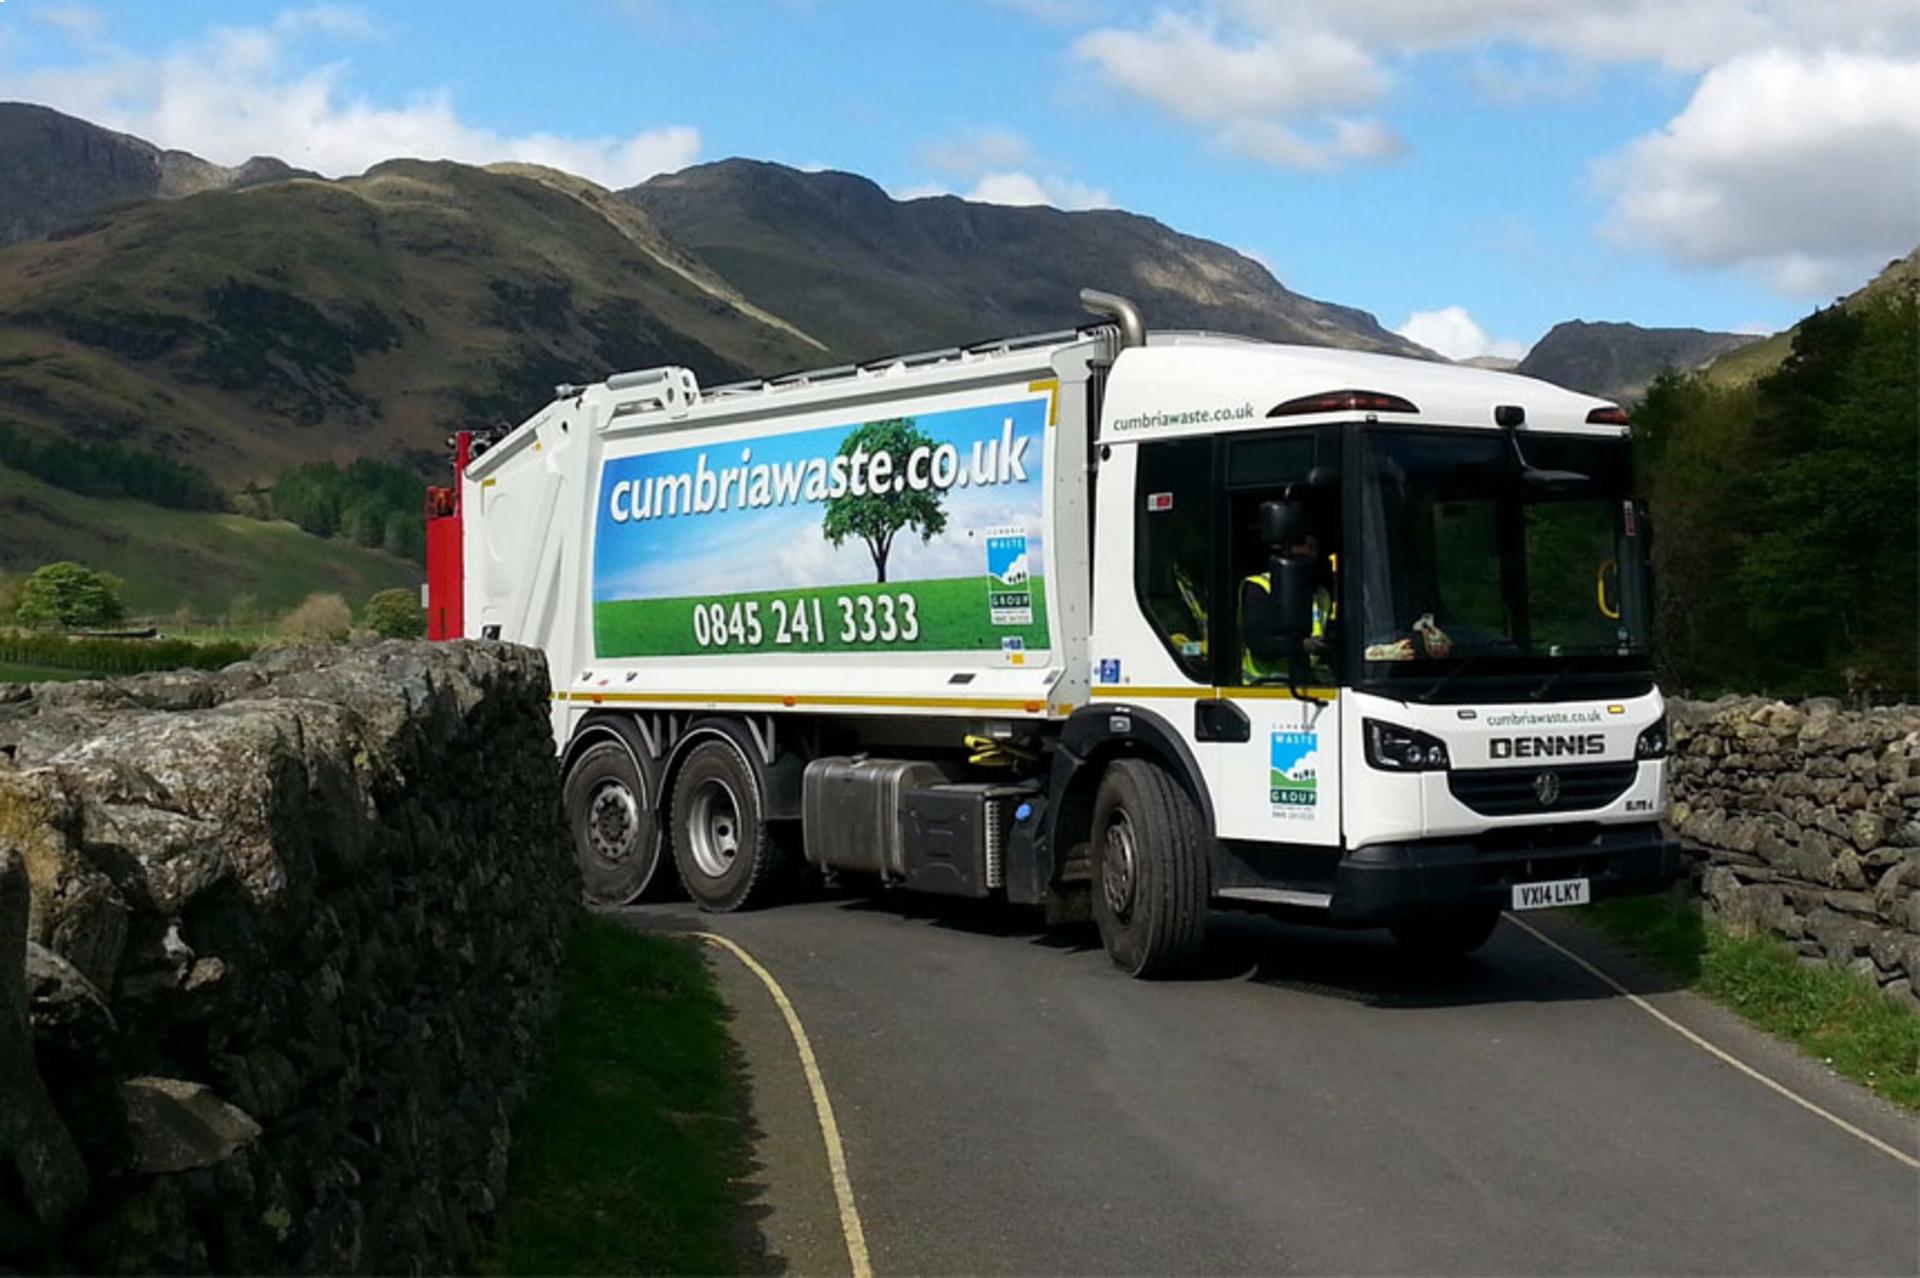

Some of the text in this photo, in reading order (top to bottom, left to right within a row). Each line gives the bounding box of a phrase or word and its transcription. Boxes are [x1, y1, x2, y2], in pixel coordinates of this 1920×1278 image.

[1113, 403, 1254, 431] cumbriawaste.co.uk
[609, 418, 1029, 523] cumbriawaste.co.uk
[694, 593, 918, 646] 0845 241 3333
[1487, 709, 1601, 726] cumbriawaste.co.uk
[1489, 734, 1605, 759] DENNIS
[1271, 791, 1315, 803] GROUP
[1522, 882, 1581, 906] VX14 LKY
